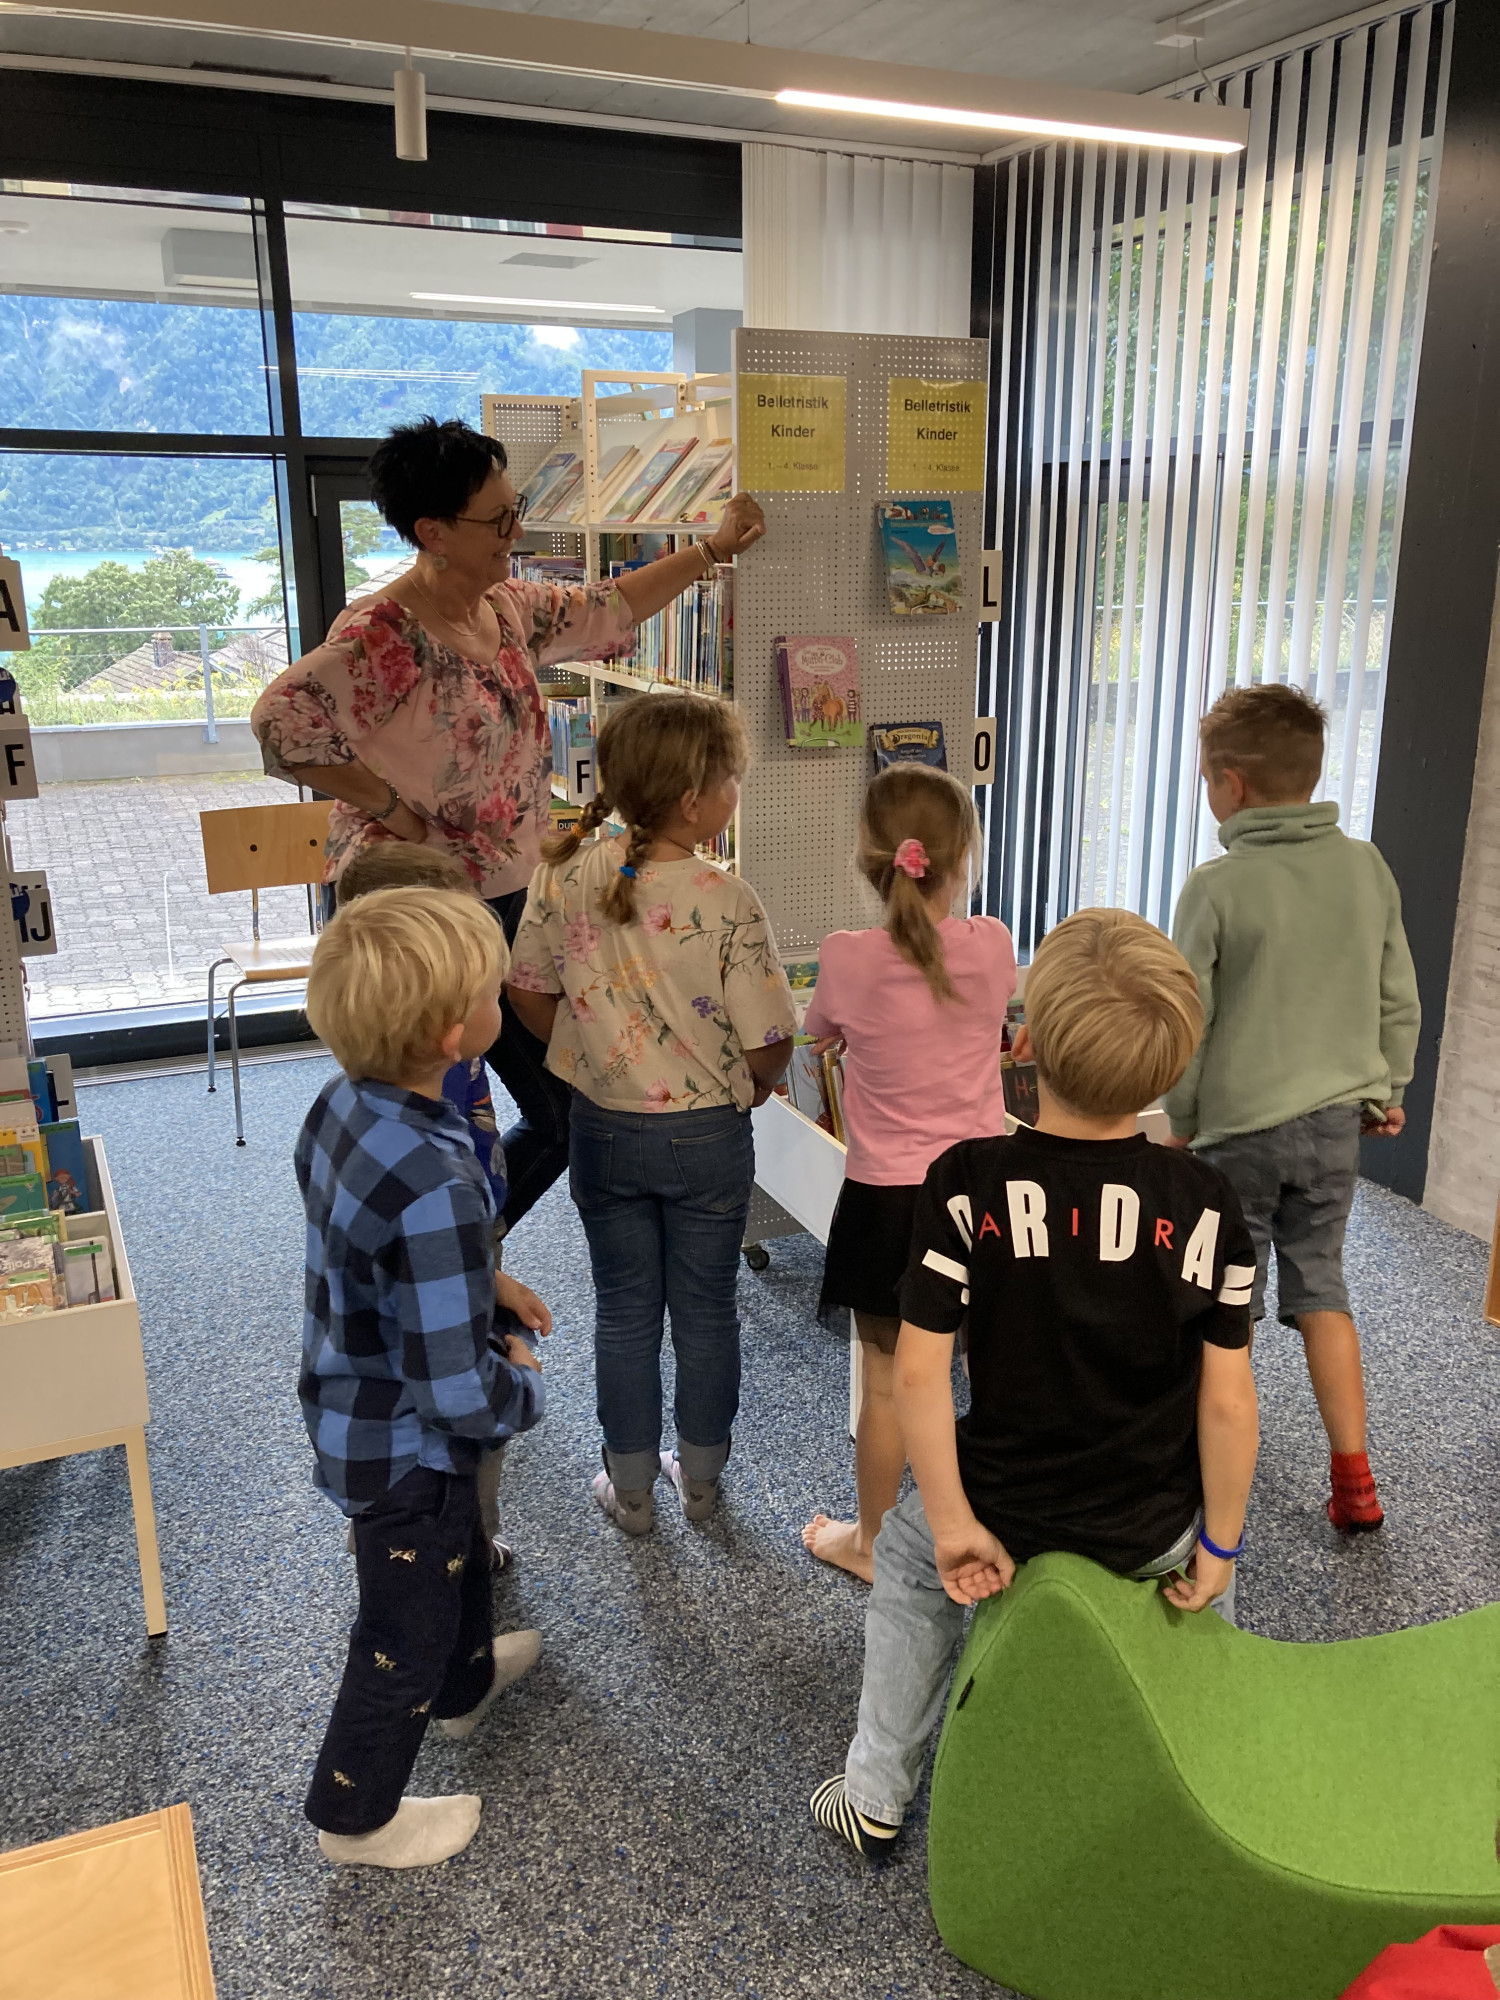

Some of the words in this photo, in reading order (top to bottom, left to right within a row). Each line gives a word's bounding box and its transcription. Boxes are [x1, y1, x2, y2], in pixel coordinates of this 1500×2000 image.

[757, 394, 829, 410] Belletristik
[904, 399, 971, 413] Belletristik
[771, 424, 815, 438] Kinder
[917, 428, 958, 441] Kinder
[793, 461, 818, 471] Klasse
[936, 463, 960, 472] Klasse
[983, 566, 998, 608] L
[974, 731, 991, 772] O
[5, 744, 26, 786] F
[576, 760, 590, 794] F
